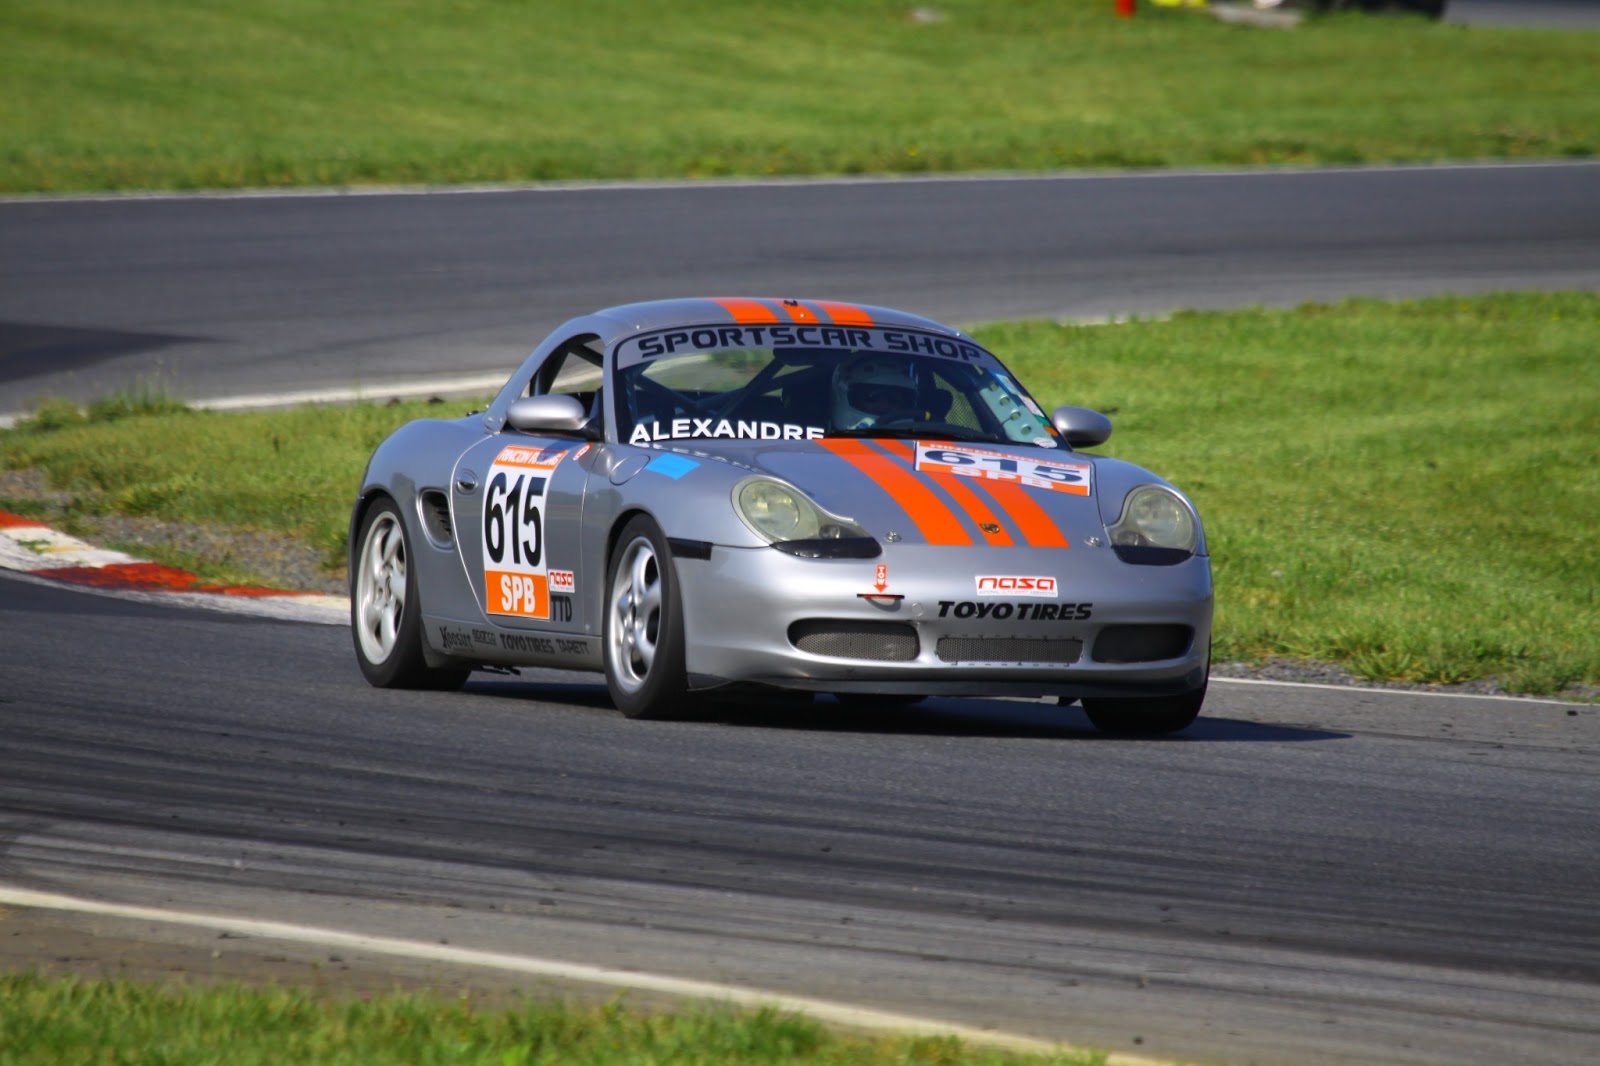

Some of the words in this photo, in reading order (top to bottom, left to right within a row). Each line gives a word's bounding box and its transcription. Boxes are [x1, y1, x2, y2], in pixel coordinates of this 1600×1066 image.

[638, 328, 871, 358] SPORTSCAR
[884, 332, 981, 362] SHOP
[629, 418, 825, 444] ALEXANDRE
[925, 450, 1083, 482] 615
[951, 466, 1054, 490] SPB
[485, 472, 547, 568] 615
[550, 571, 573, 587] nasa
[877, 566, 886, 586] TOW
[978, 577, 1055, 591] nasa
[501, 574, 536, 613] SPB
[551, 595, 573, 622] TTD
[938, 600, 1013, 620] TOYO
[1016, 602, 1093, 621] TIRES
[499, 633, 527, 651] TOYO
[525, 636, 555, 655] TIRES
